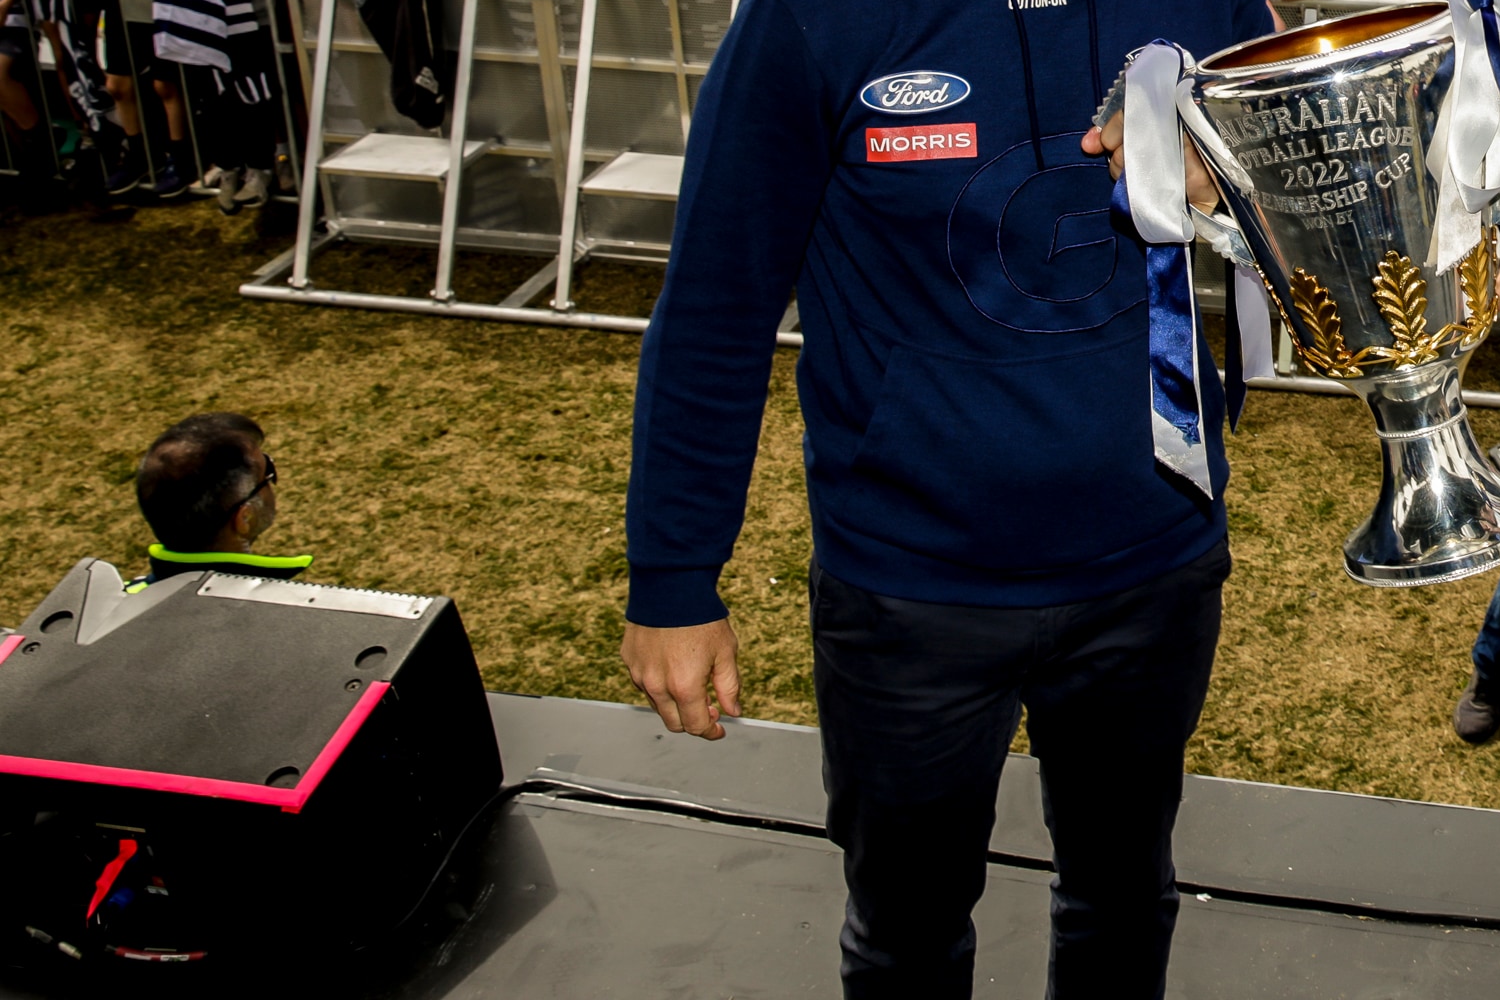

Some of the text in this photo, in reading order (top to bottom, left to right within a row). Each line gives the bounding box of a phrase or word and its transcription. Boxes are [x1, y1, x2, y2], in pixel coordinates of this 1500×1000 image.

[881, 78, 950, 107] Ford
[1215, 90, 1398, 150] AUSTRALIAN
[869, 132, 971, 153] MORRIS
[1237, 126, 1415, 170] OTBALL LEAGUE
[1251, 152, 1412, 215] REMIERSHIP CUP
[1281, 159, 1349, 191] 2022
[1301, 209, 1354, 231] WON BY
